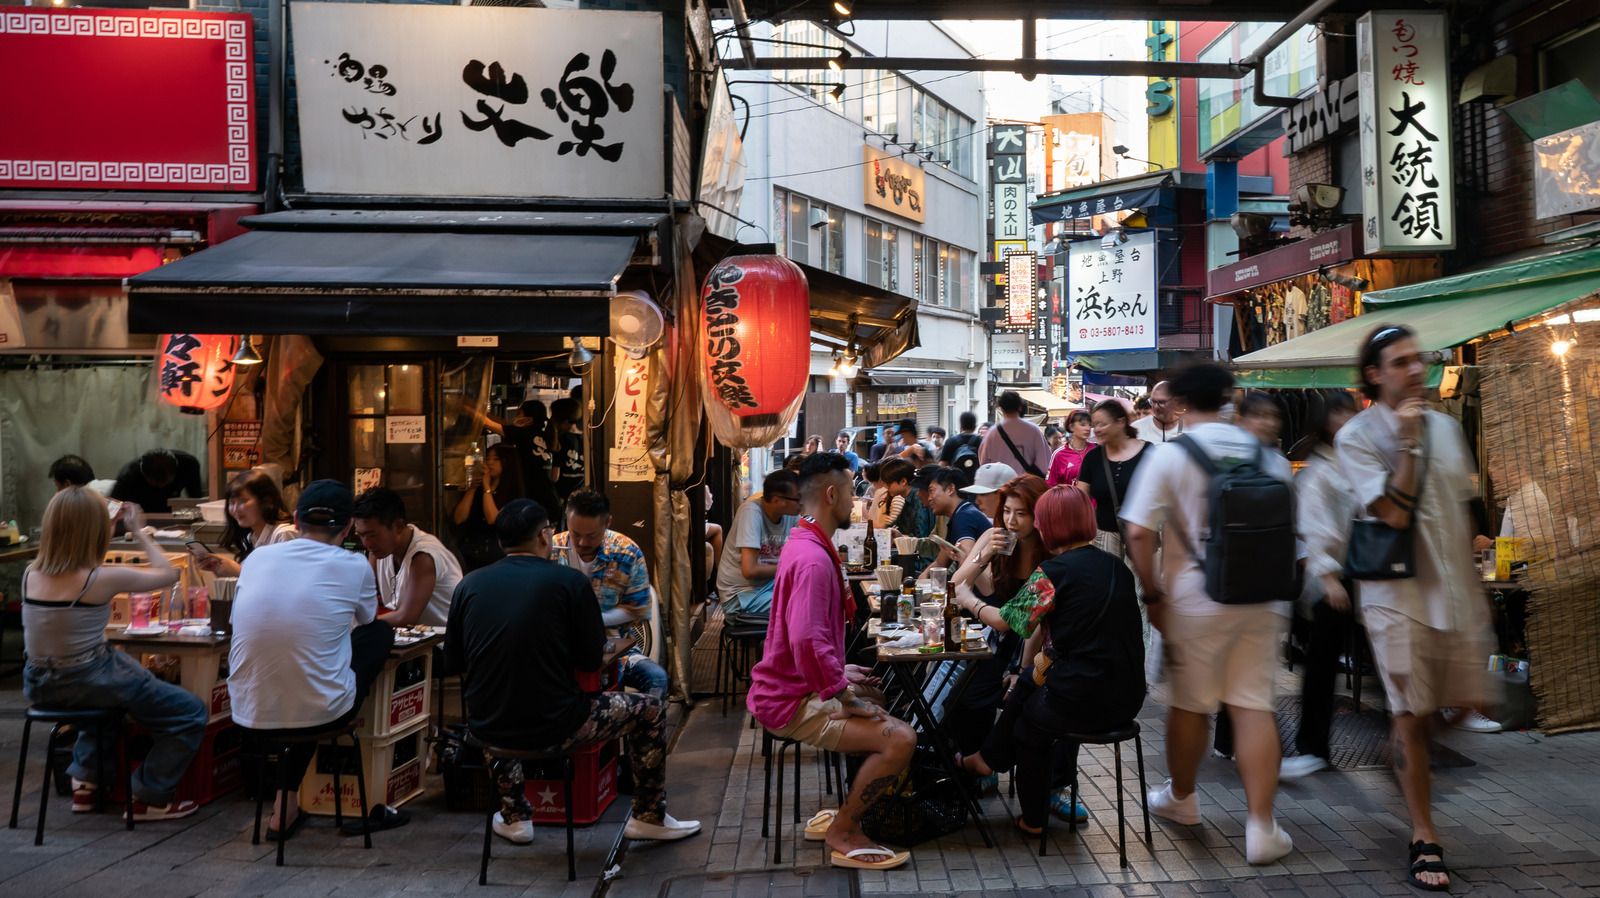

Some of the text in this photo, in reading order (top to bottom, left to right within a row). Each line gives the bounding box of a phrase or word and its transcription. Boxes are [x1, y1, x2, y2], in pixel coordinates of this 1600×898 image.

[1145, 20, 1174, 116] ts
[1391, 19, 1425, 86] もつ焼
[342, 106, 443, 145] やきとり
[996, 128, 1024, 180] 大山
[1387, 91, 1444, 240] 大統領
[1003, 186, 1018, 237] 肉の大山
[1061, 196, 1124, 220] 地魚屋台
[1081, 247, 1141, 268] 地魚屋台
[1098, 267, 1123, 285] 上野
[1076, 285, 1148, 320] 浜ちゃん
[704, 265, 760, 410] やきとり文楽
[1090, 325, 1144, 338] 03-5807-8413
[624, 354, 648, 412] ッピー
[391, 689, 423, 713] アサヒビール
[320, 782, 354, 796] Ashi
[388, 767, 420, 792] アサヒビール
